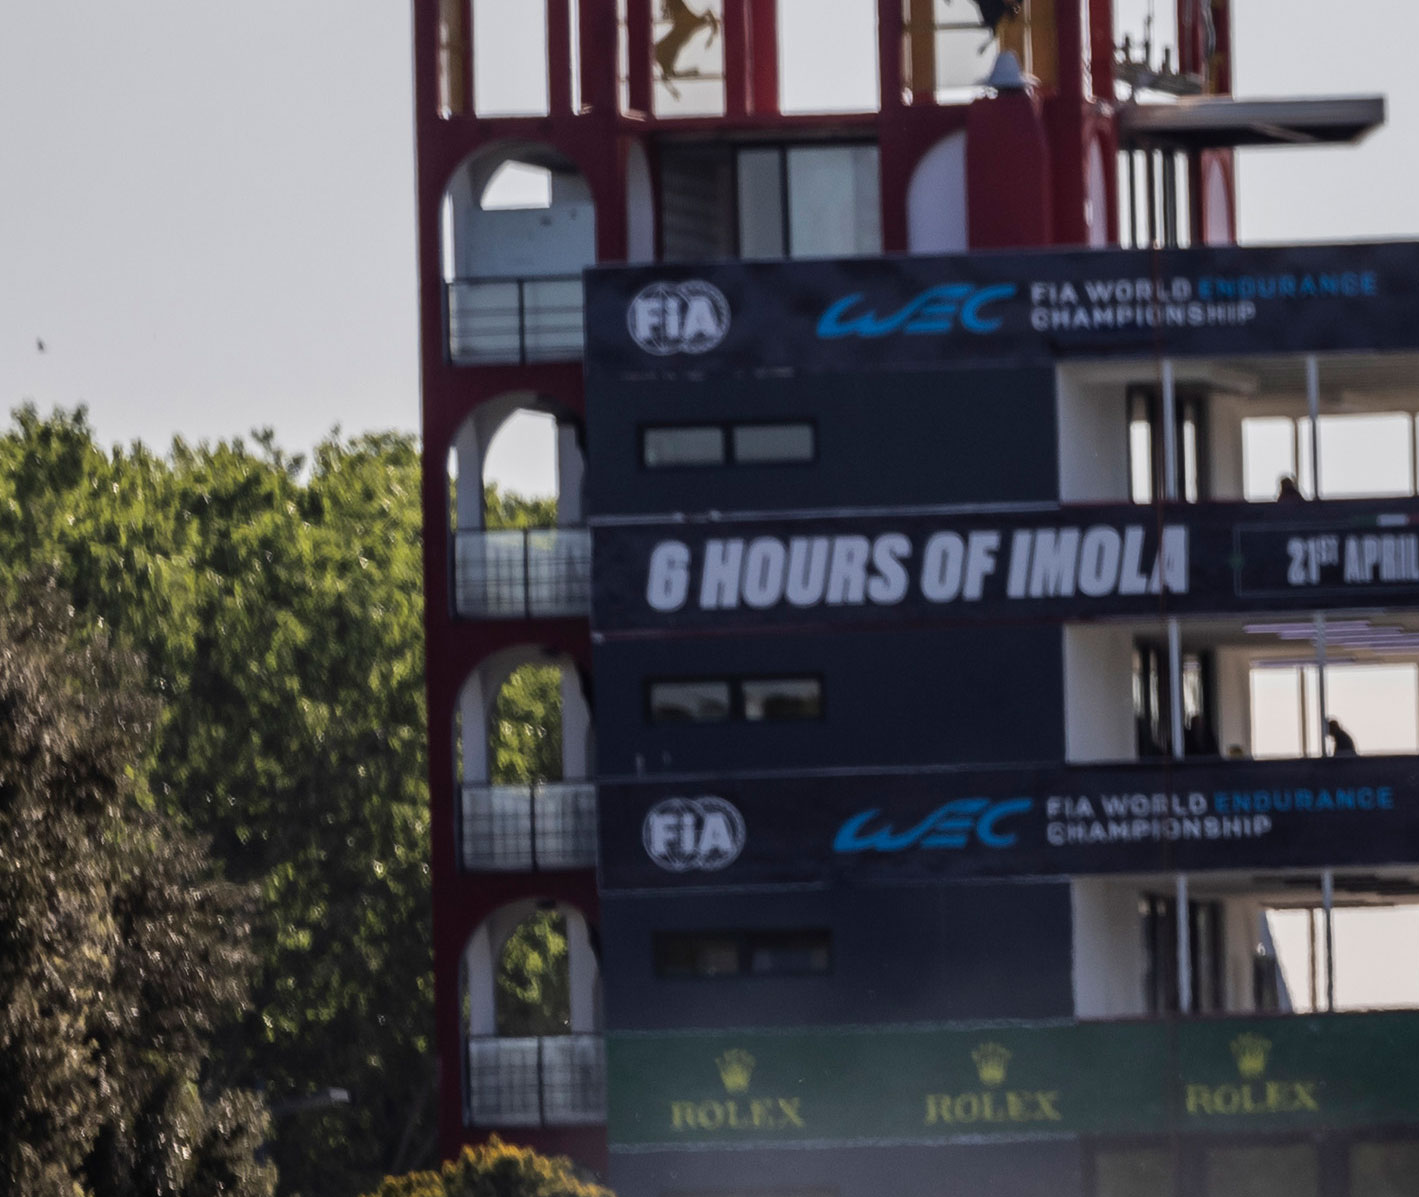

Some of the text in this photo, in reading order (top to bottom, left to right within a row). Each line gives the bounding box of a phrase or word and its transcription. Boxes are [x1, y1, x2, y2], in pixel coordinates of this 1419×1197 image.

[1031, 271, 1377, 307] FIA WORLD ENDURANCE
[635, 297, 724, 340] FIA
[817, 283, 1016, 338] WEC
[1031, 299, 1256, 332] CHAMPIONSHIP
[647, 525, 1190, 612] 6 HOURS OF IMOLA
[1046, 786, 1395, 819] FIA WORLD ENDURANCE
[650, 812, 736, 855] FIA
[833, 798, 1032, 853] WEC
[1046, 814, 1273, 846] CHAMPIONSHIP
[670, 1096, 806, 1132] ROLEX
[925, 1089, 1063, 1126] ROLEX
[1184, 1079, 1320, 1115] ROLEX
